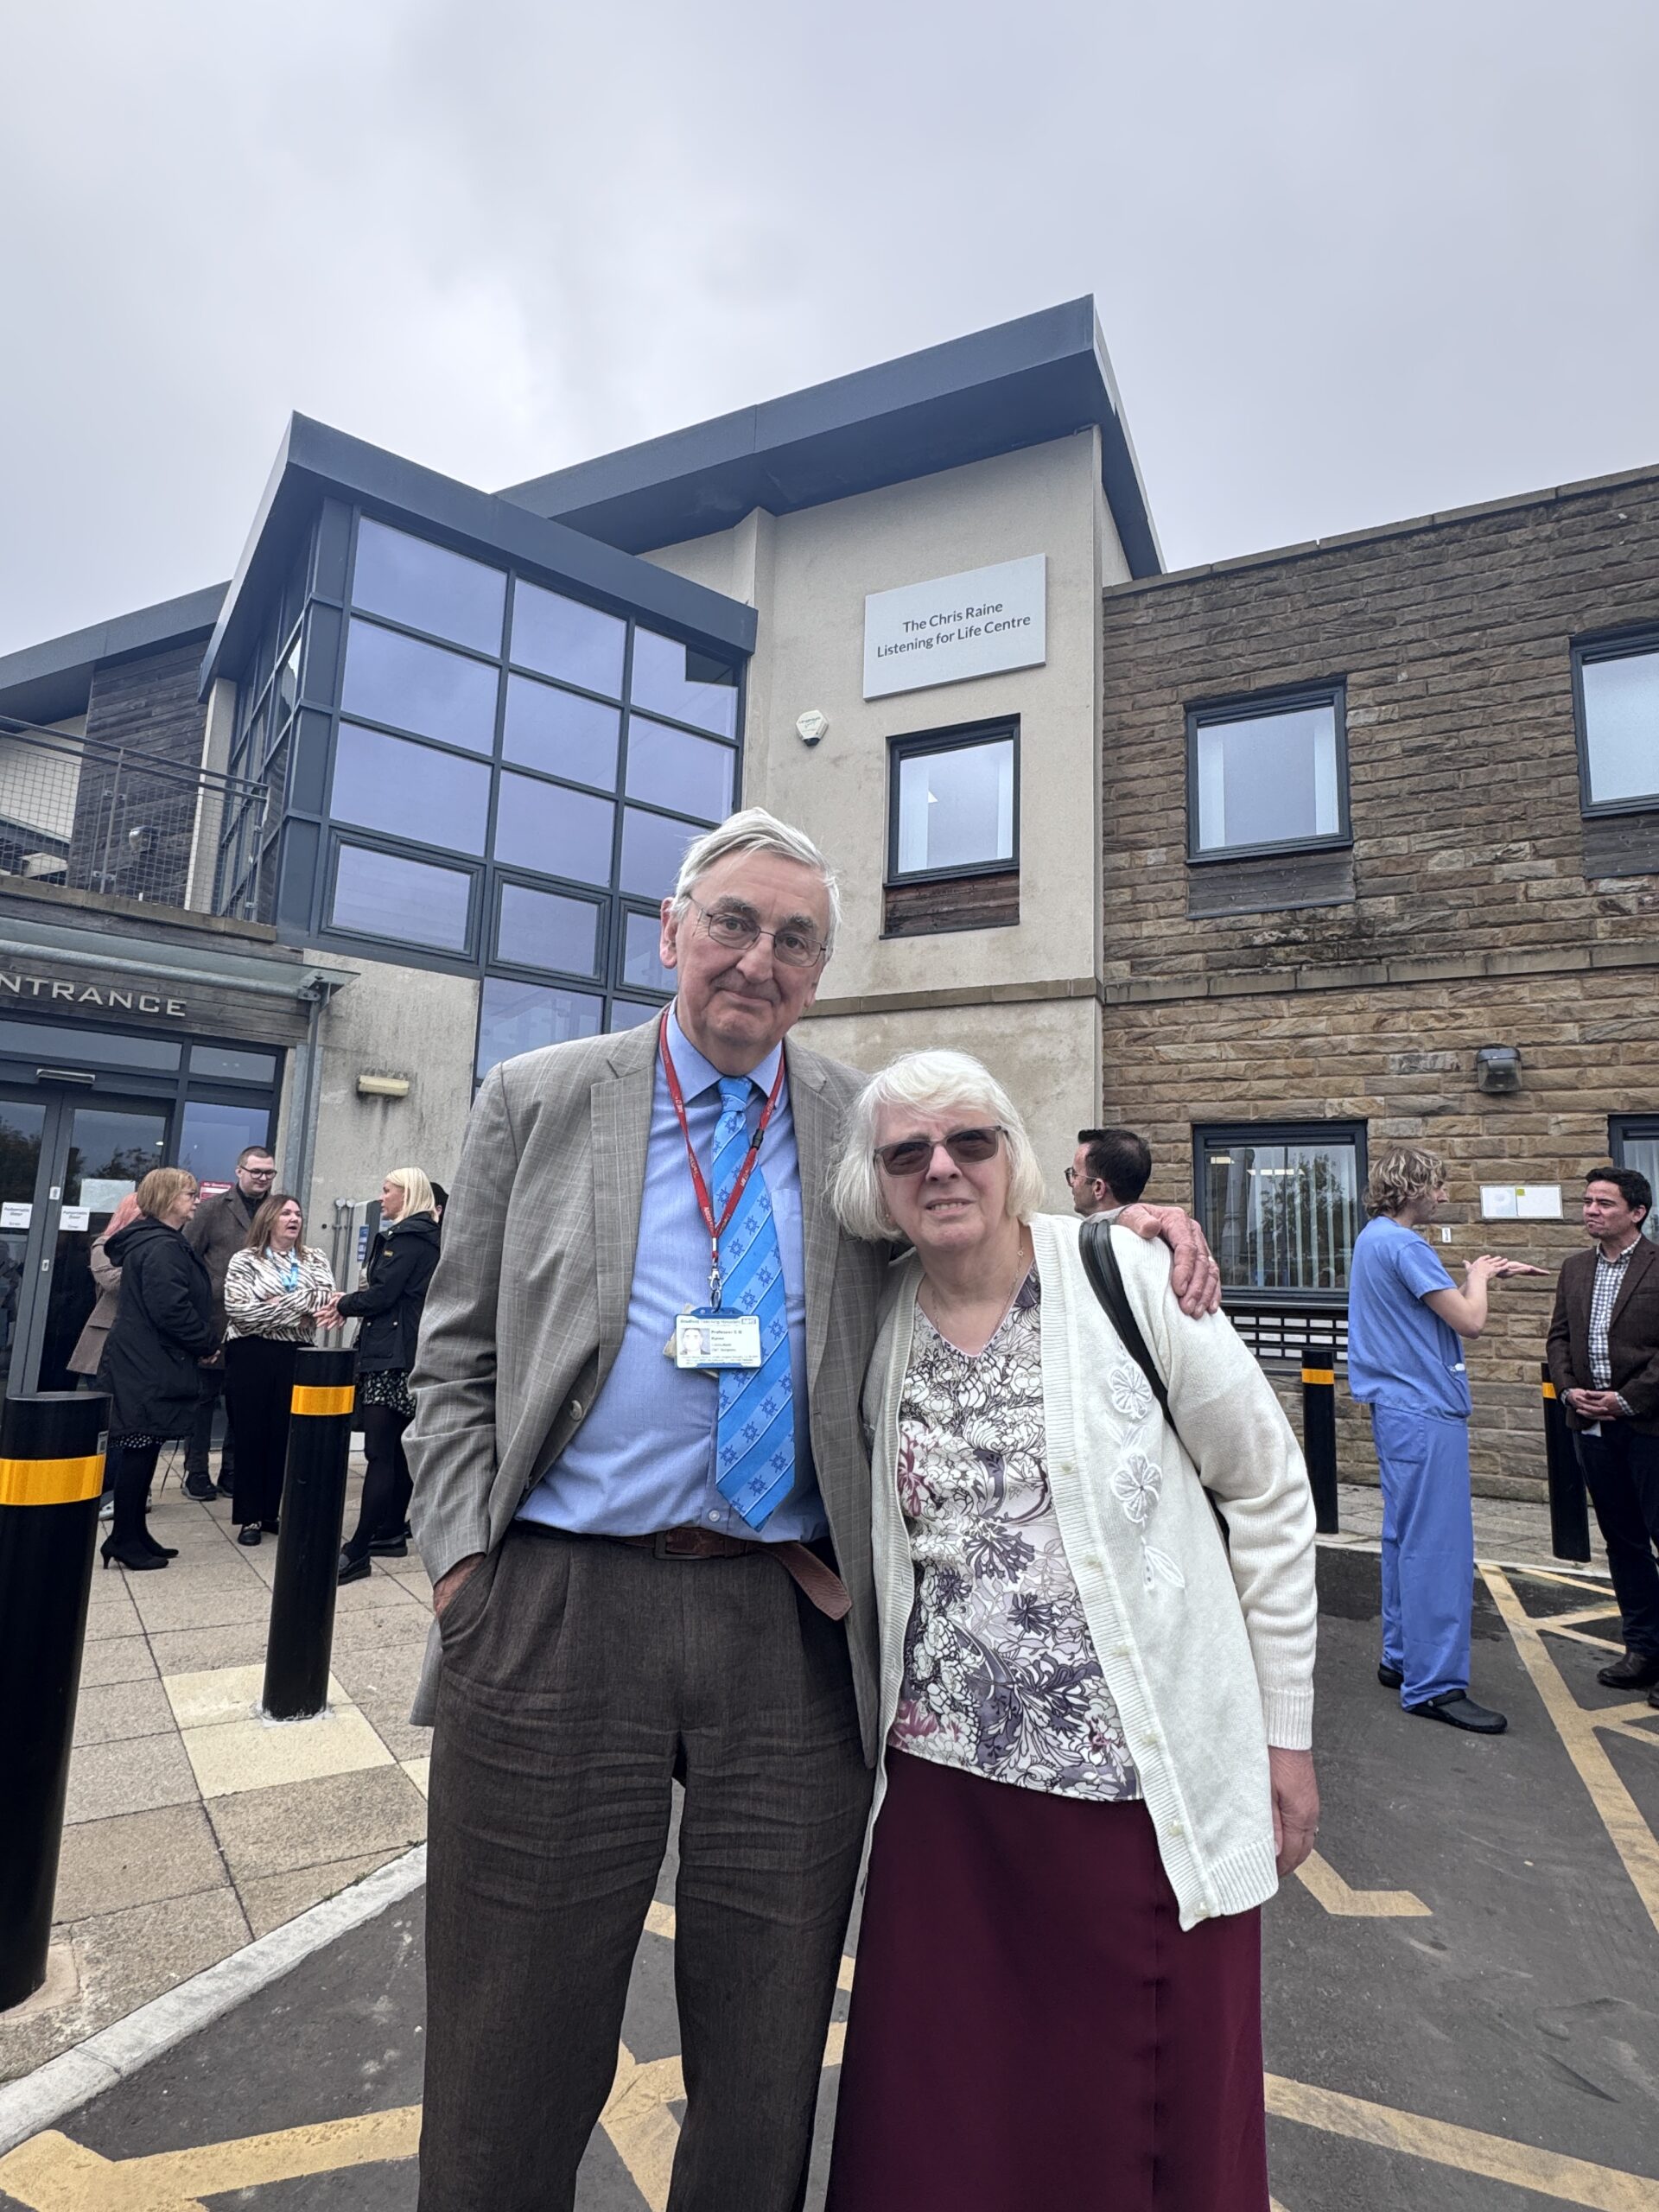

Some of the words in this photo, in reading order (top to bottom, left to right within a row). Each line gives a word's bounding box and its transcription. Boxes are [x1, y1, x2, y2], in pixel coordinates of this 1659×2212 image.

[877, 637, 933, 658] Listening
[936, 632, 955, 645] for
[957, 625, 982, 640] Life
[984, 615, 1031, 634] Centre
[902, 619, 927, 633] The
[929, 610, 963, 627] Chris
[965, 603, 1003, 620] Raine
[0, 972, 187, 1017] NTRANCE
